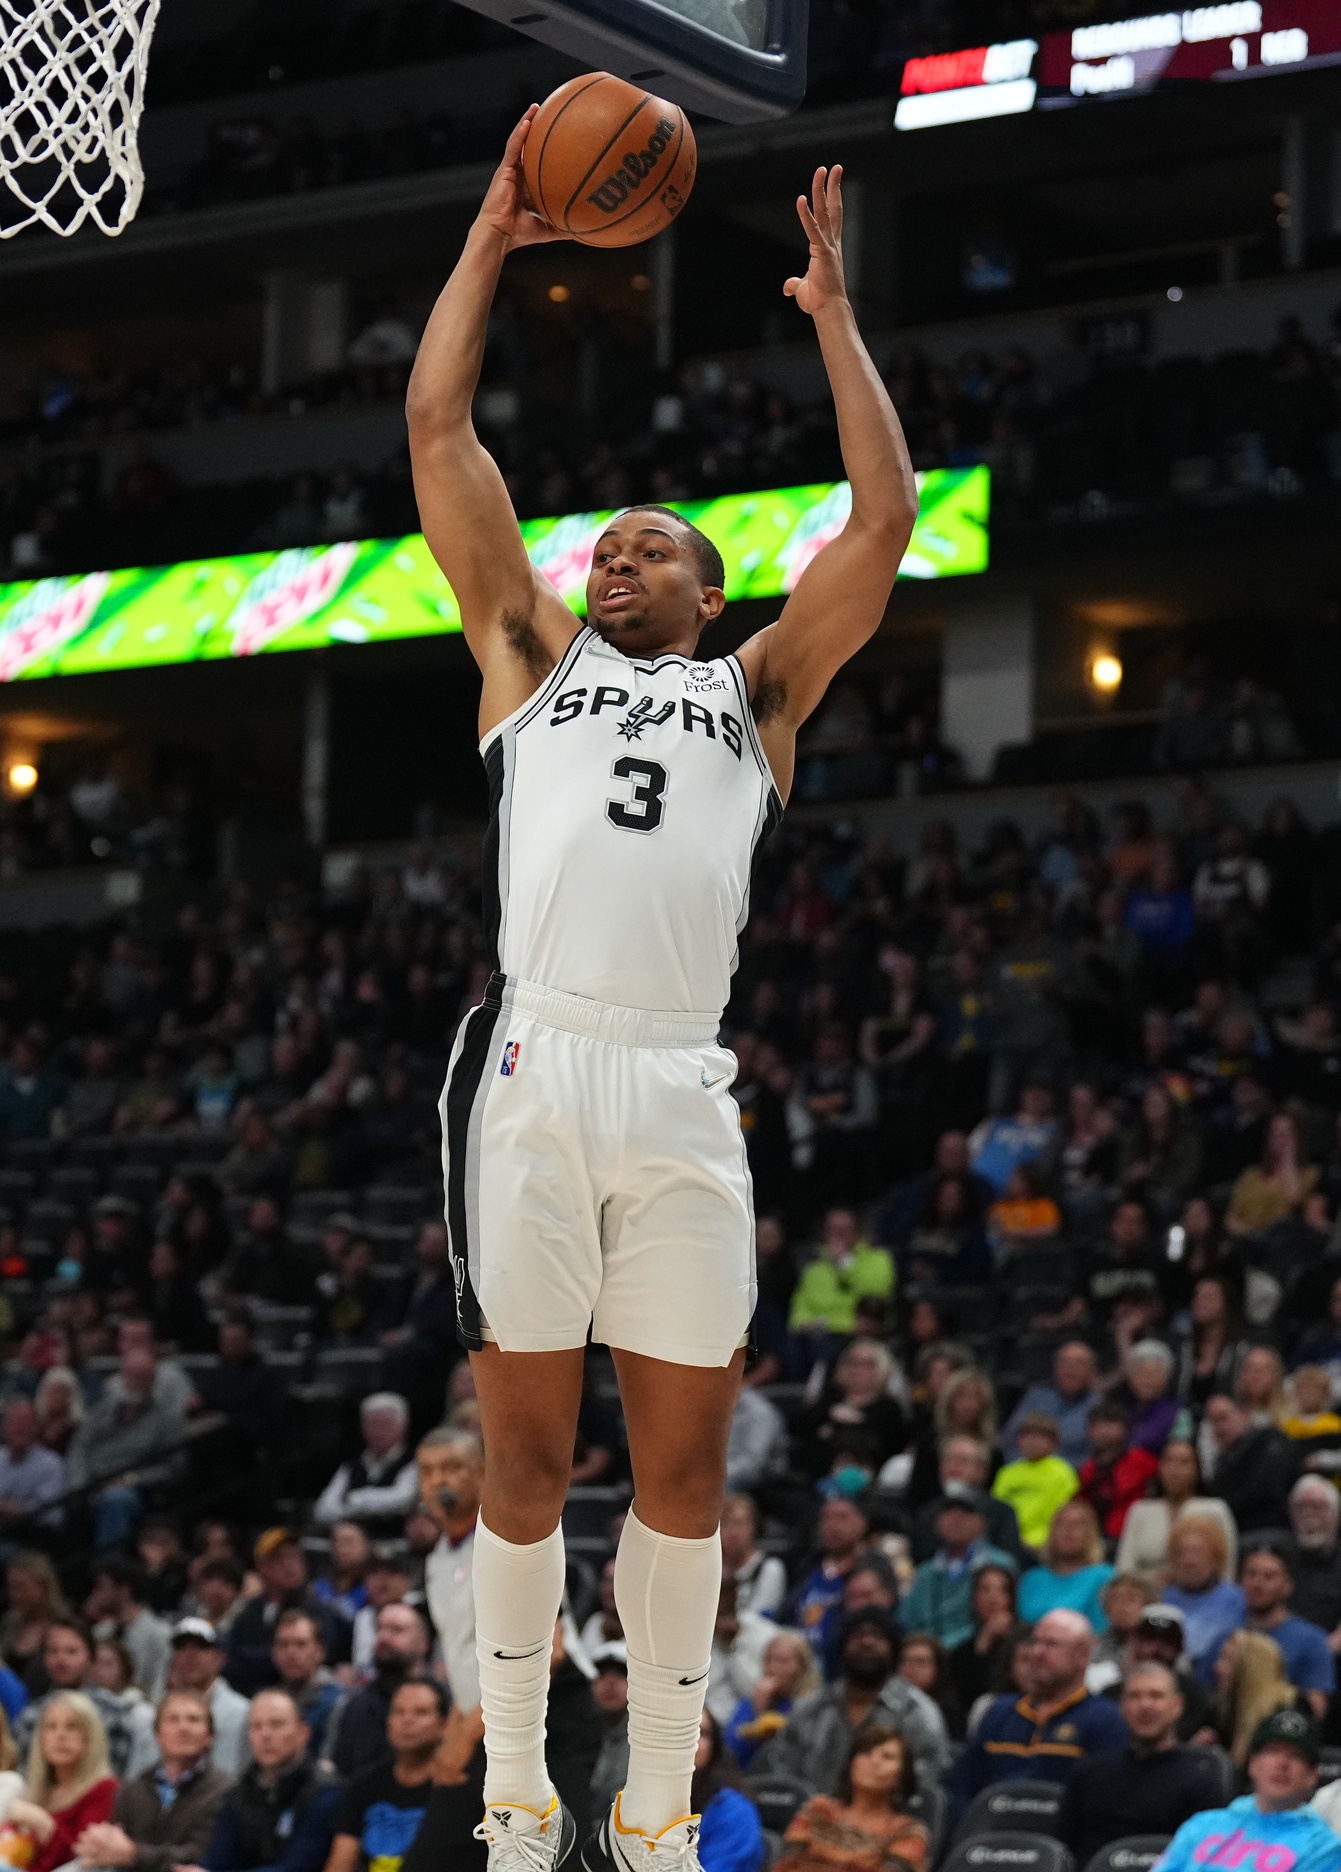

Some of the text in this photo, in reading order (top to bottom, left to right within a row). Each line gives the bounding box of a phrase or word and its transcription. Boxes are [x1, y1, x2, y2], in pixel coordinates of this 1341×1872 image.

[586, 116, 676, 213] Wilson
[550, 687, 743, 762] SPURS
[683, 678, 730, 693] Frost
[604, 753, 670, 836] 3
